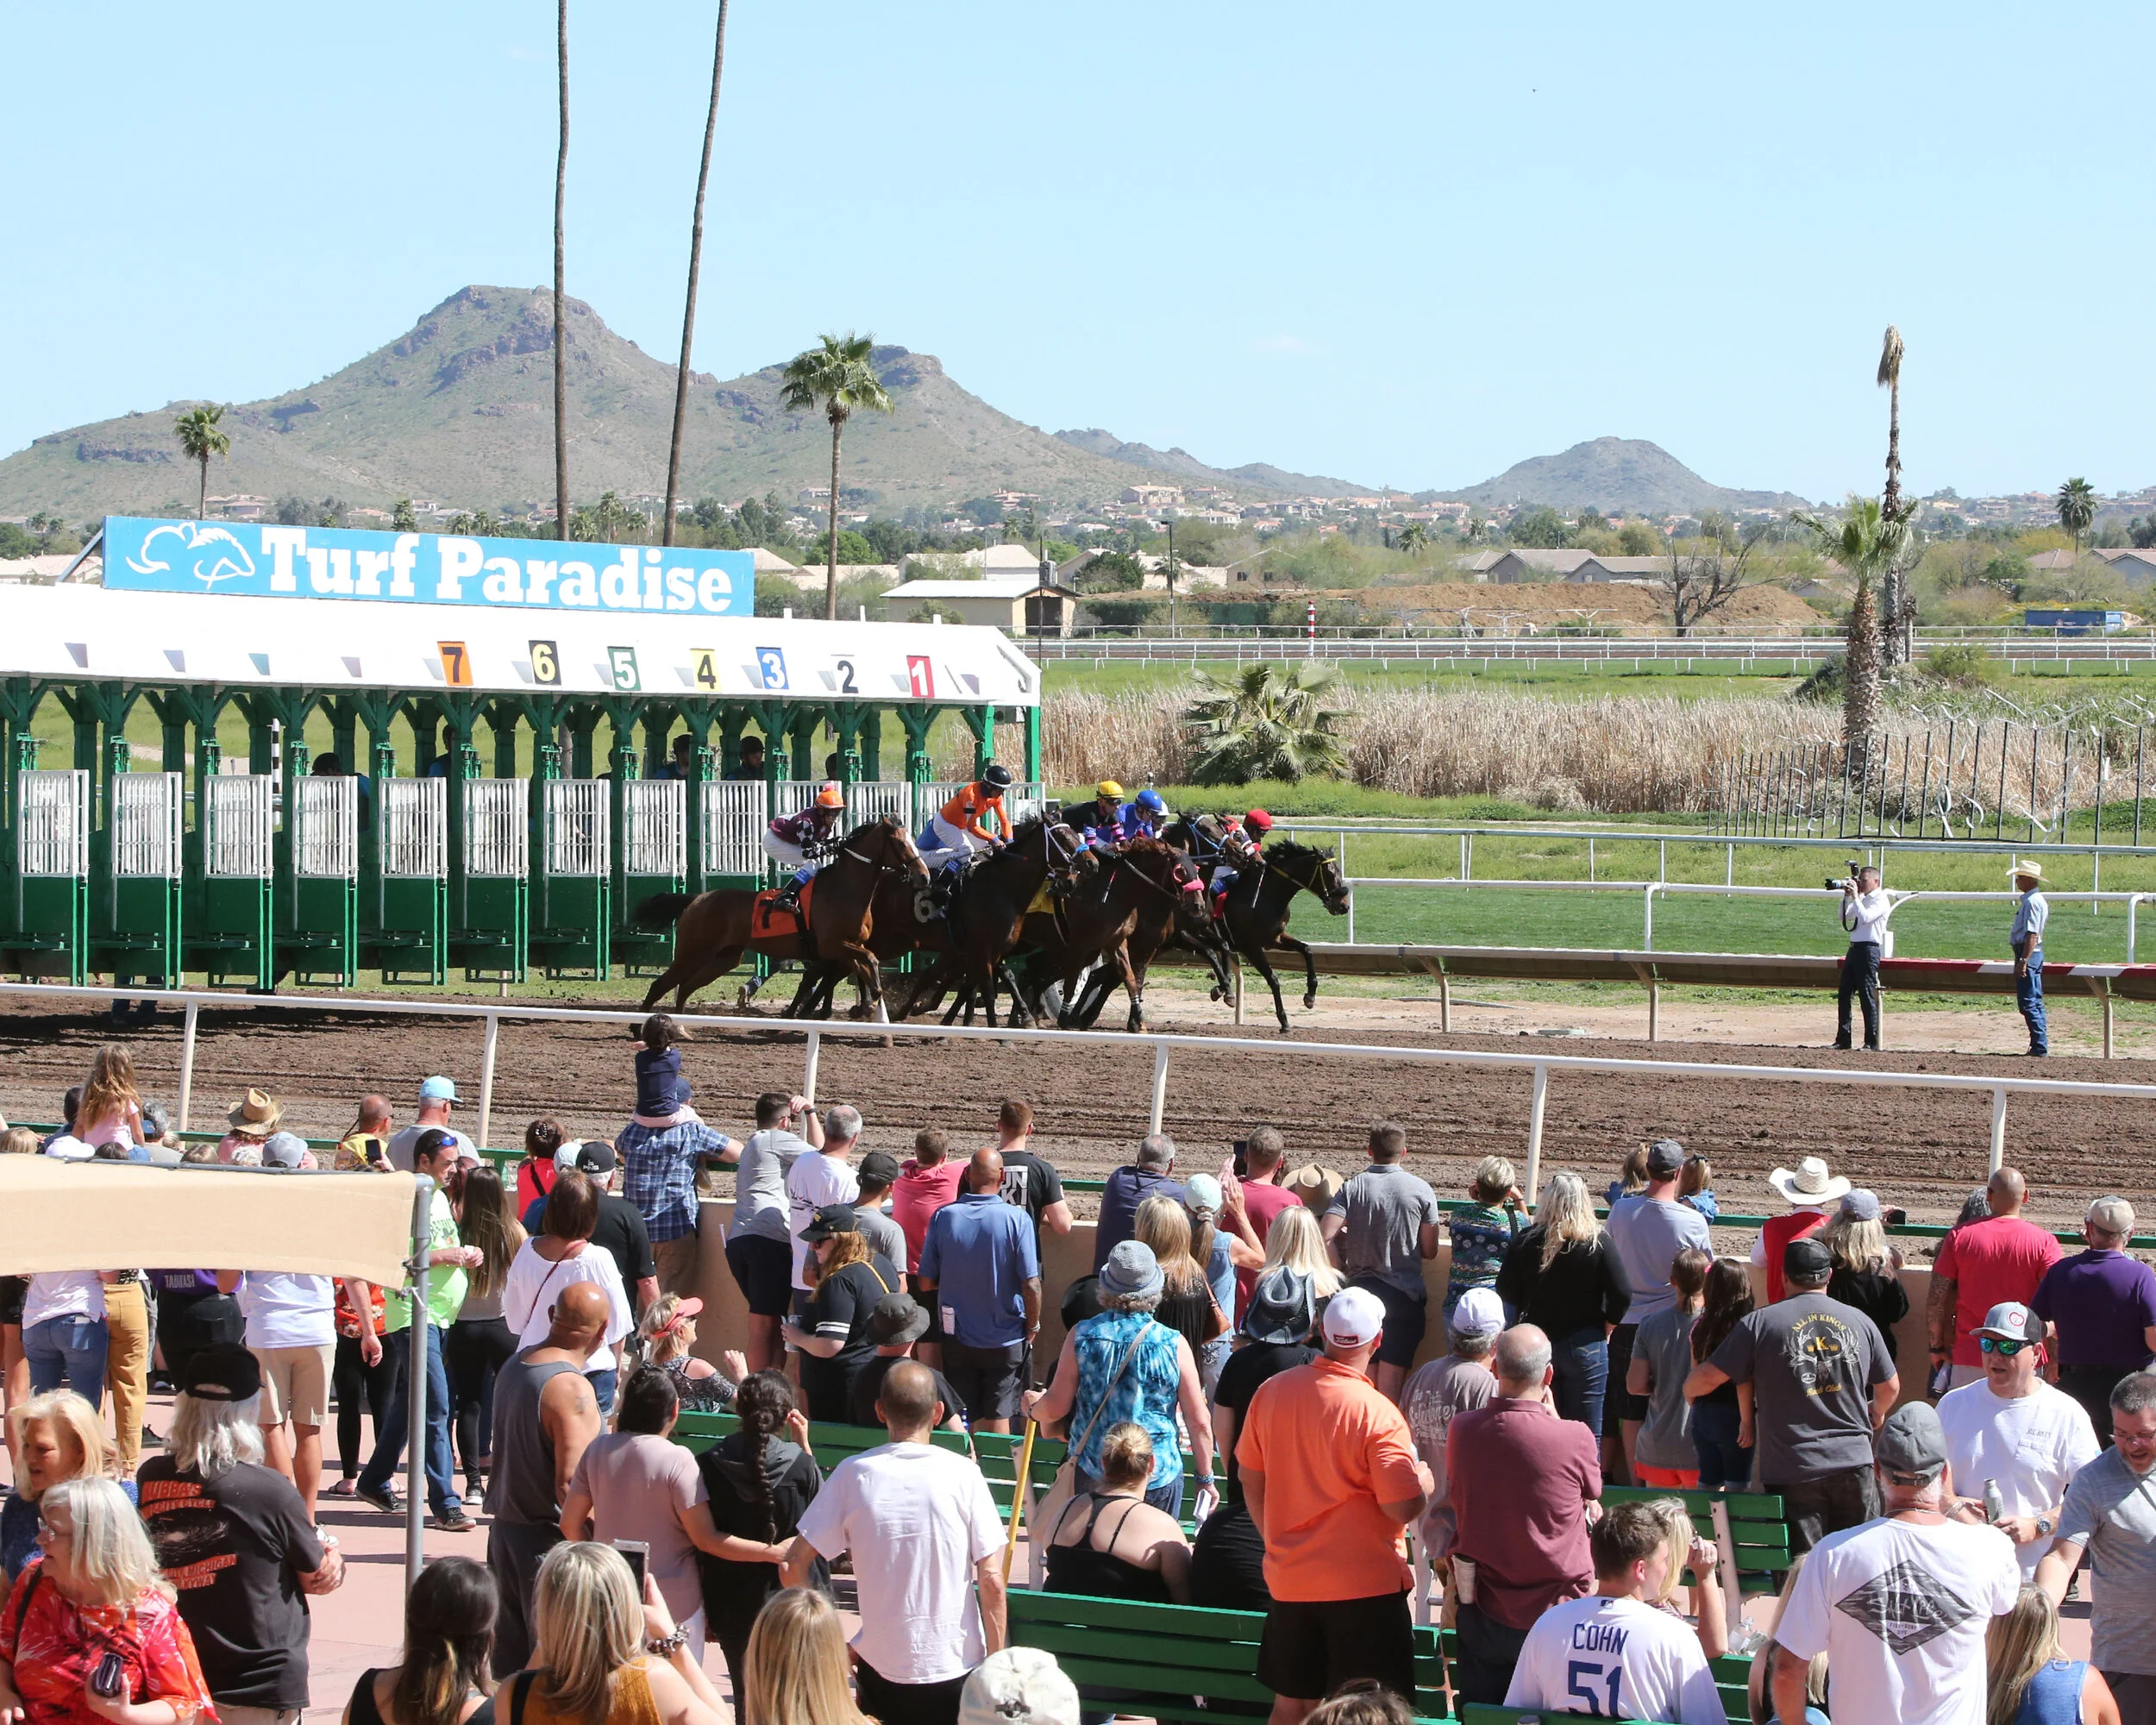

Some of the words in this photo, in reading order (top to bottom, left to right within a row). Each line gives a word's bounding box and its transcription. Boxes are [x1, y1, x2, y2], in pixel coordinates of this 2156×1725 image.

[261, 527, 420, 597] Turf
[436, 536, 732, 612] Paradise
[442, 647, 461, 683] 7
[531, 643, 556, 682] 6
[613, 651, 636, 689] 5
[697, 655, 717, 690] 4
[761, 652, 786, 689] 3
[837, 660, 859, 694] 2
[911, 660, 929, 696] 1
[759, 899, 776, 929] 7
[914, 889, 937, 923] 6
[1792, 1318, 1808, 1333] ALL
[1808, 1314, 1818, 1323] IN
[1820, 1314, 1846, 1331] KINGS
[1815, 1337, 1829, 1351] K
[1573, 1623, 1630, 1656] COHN
[1568, 1660, 1622, 1718] 51
